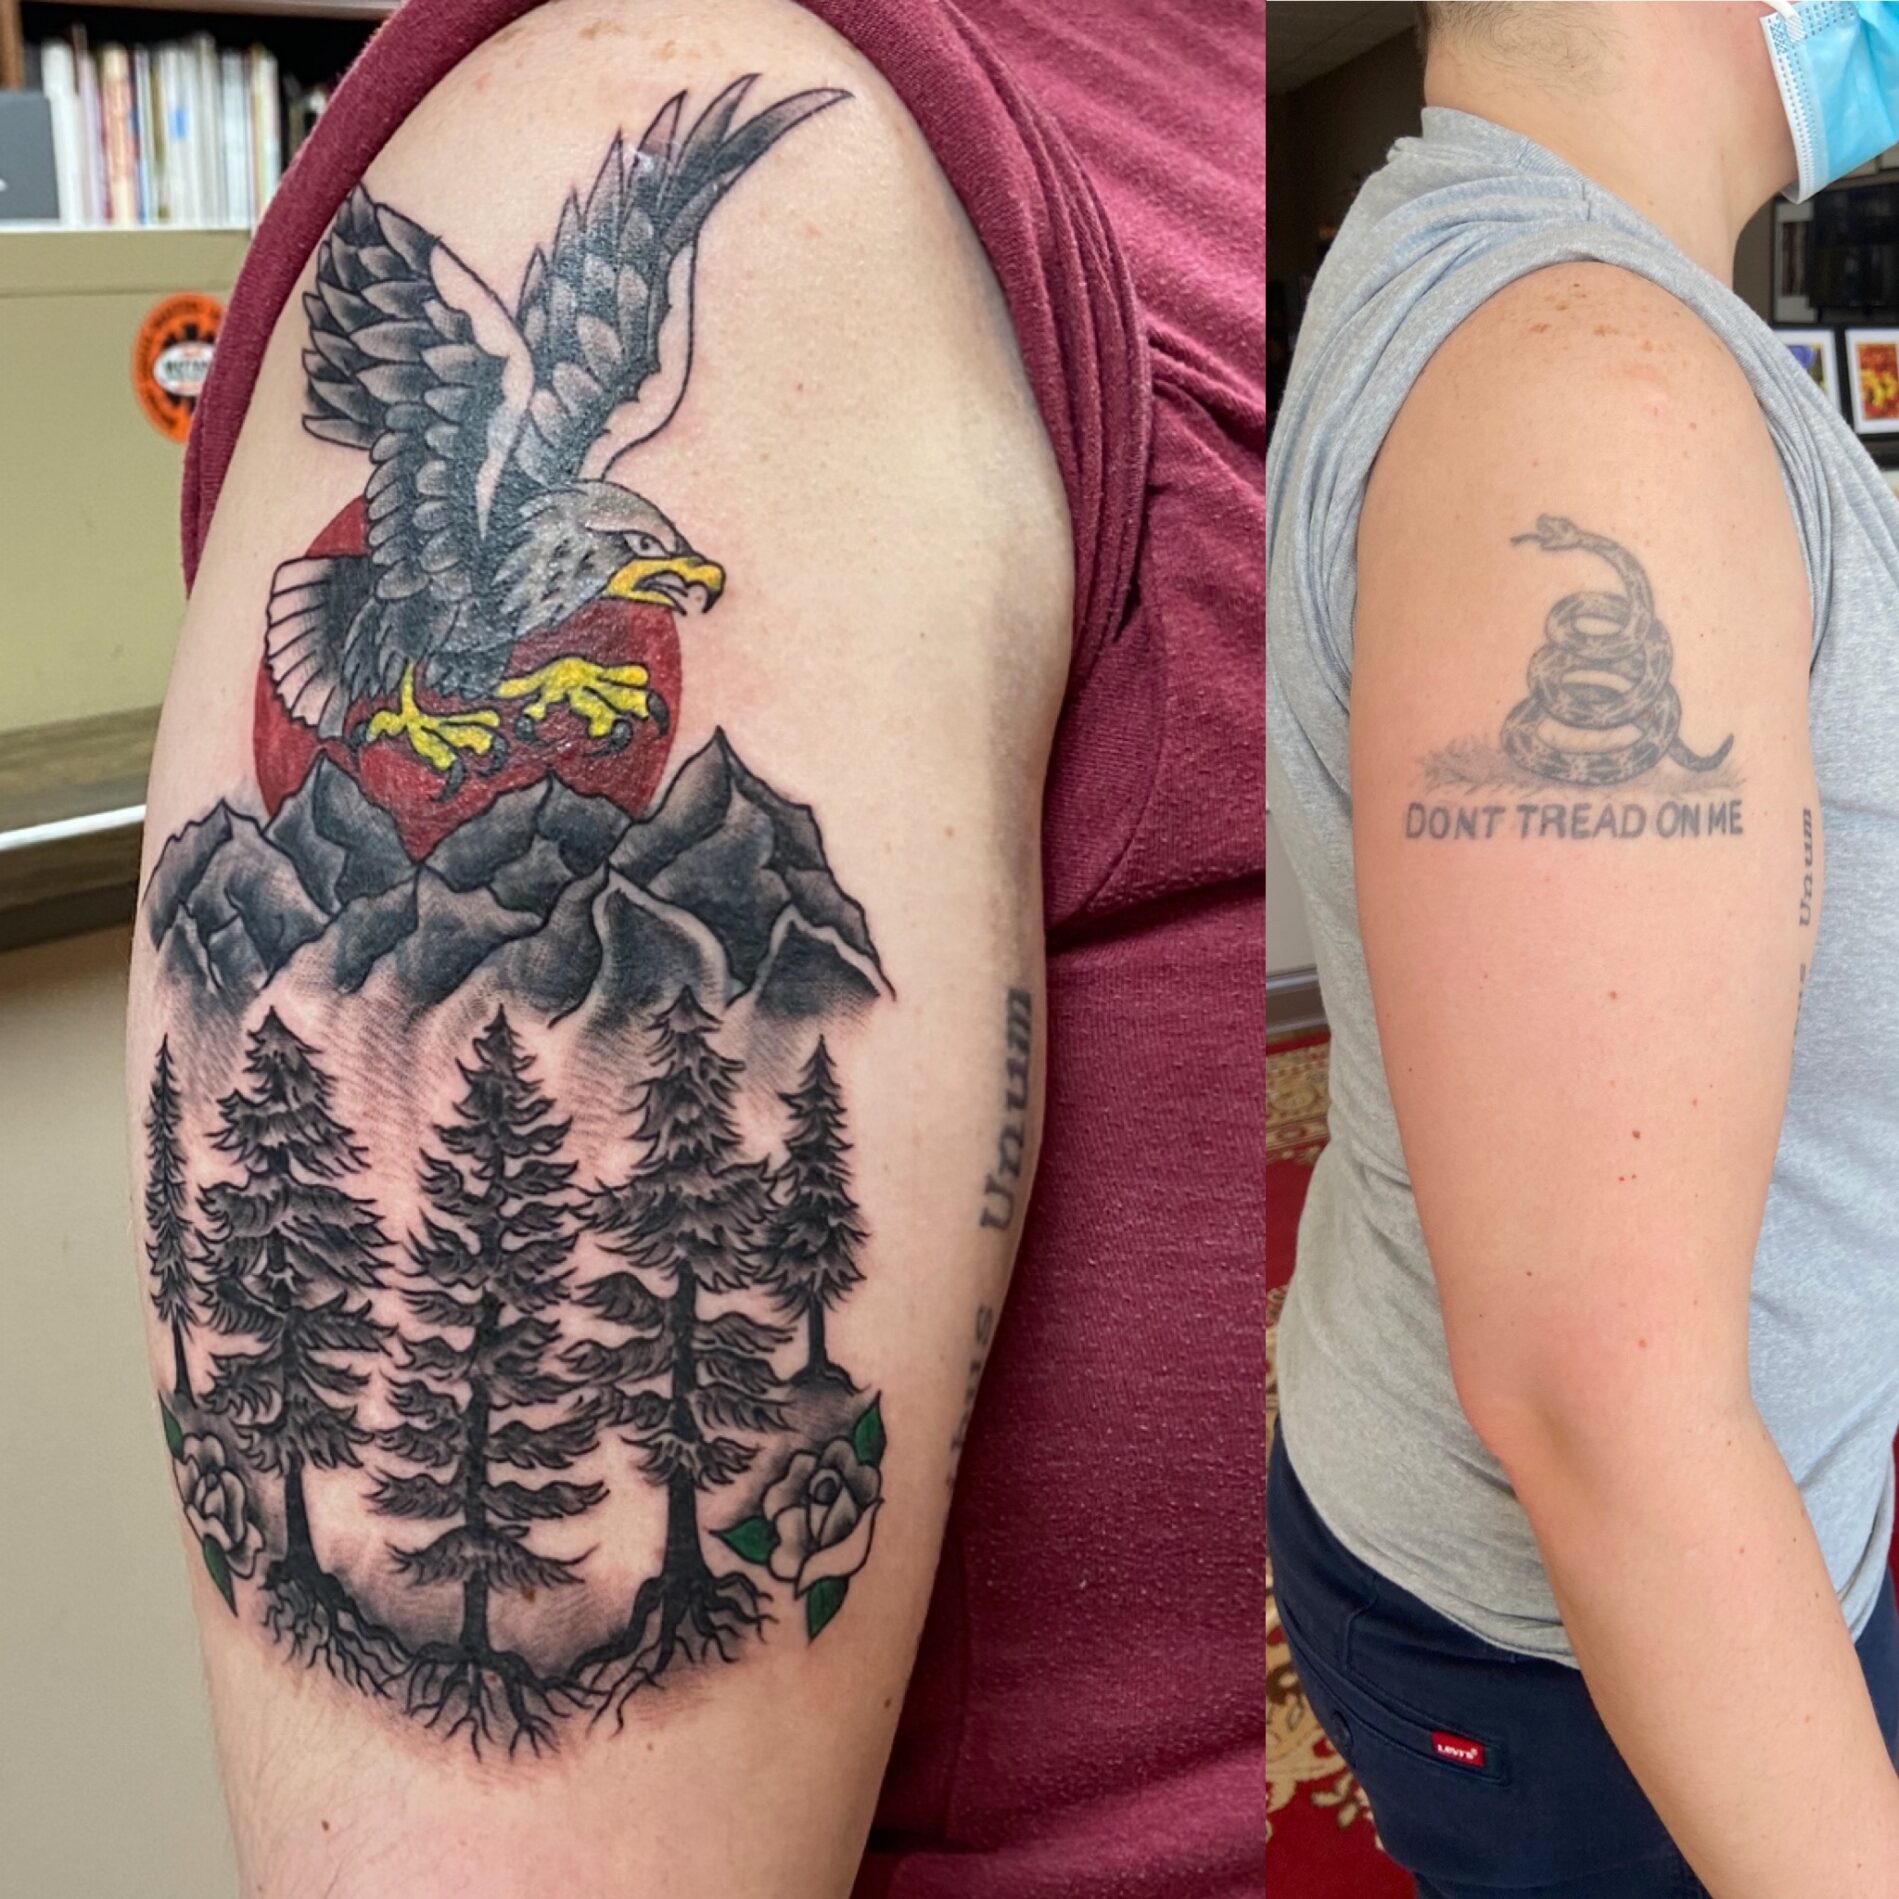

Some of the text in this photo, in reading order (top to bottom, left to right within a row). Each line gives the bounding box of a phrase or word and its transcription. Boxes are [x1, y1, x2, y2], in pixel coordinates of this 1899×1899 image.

[1405, 799, 1745, 840] DONT TREAD ON ME
[1799, 807, 1814, 926] Unum
[980, 987, 1033, 1232] Unum
